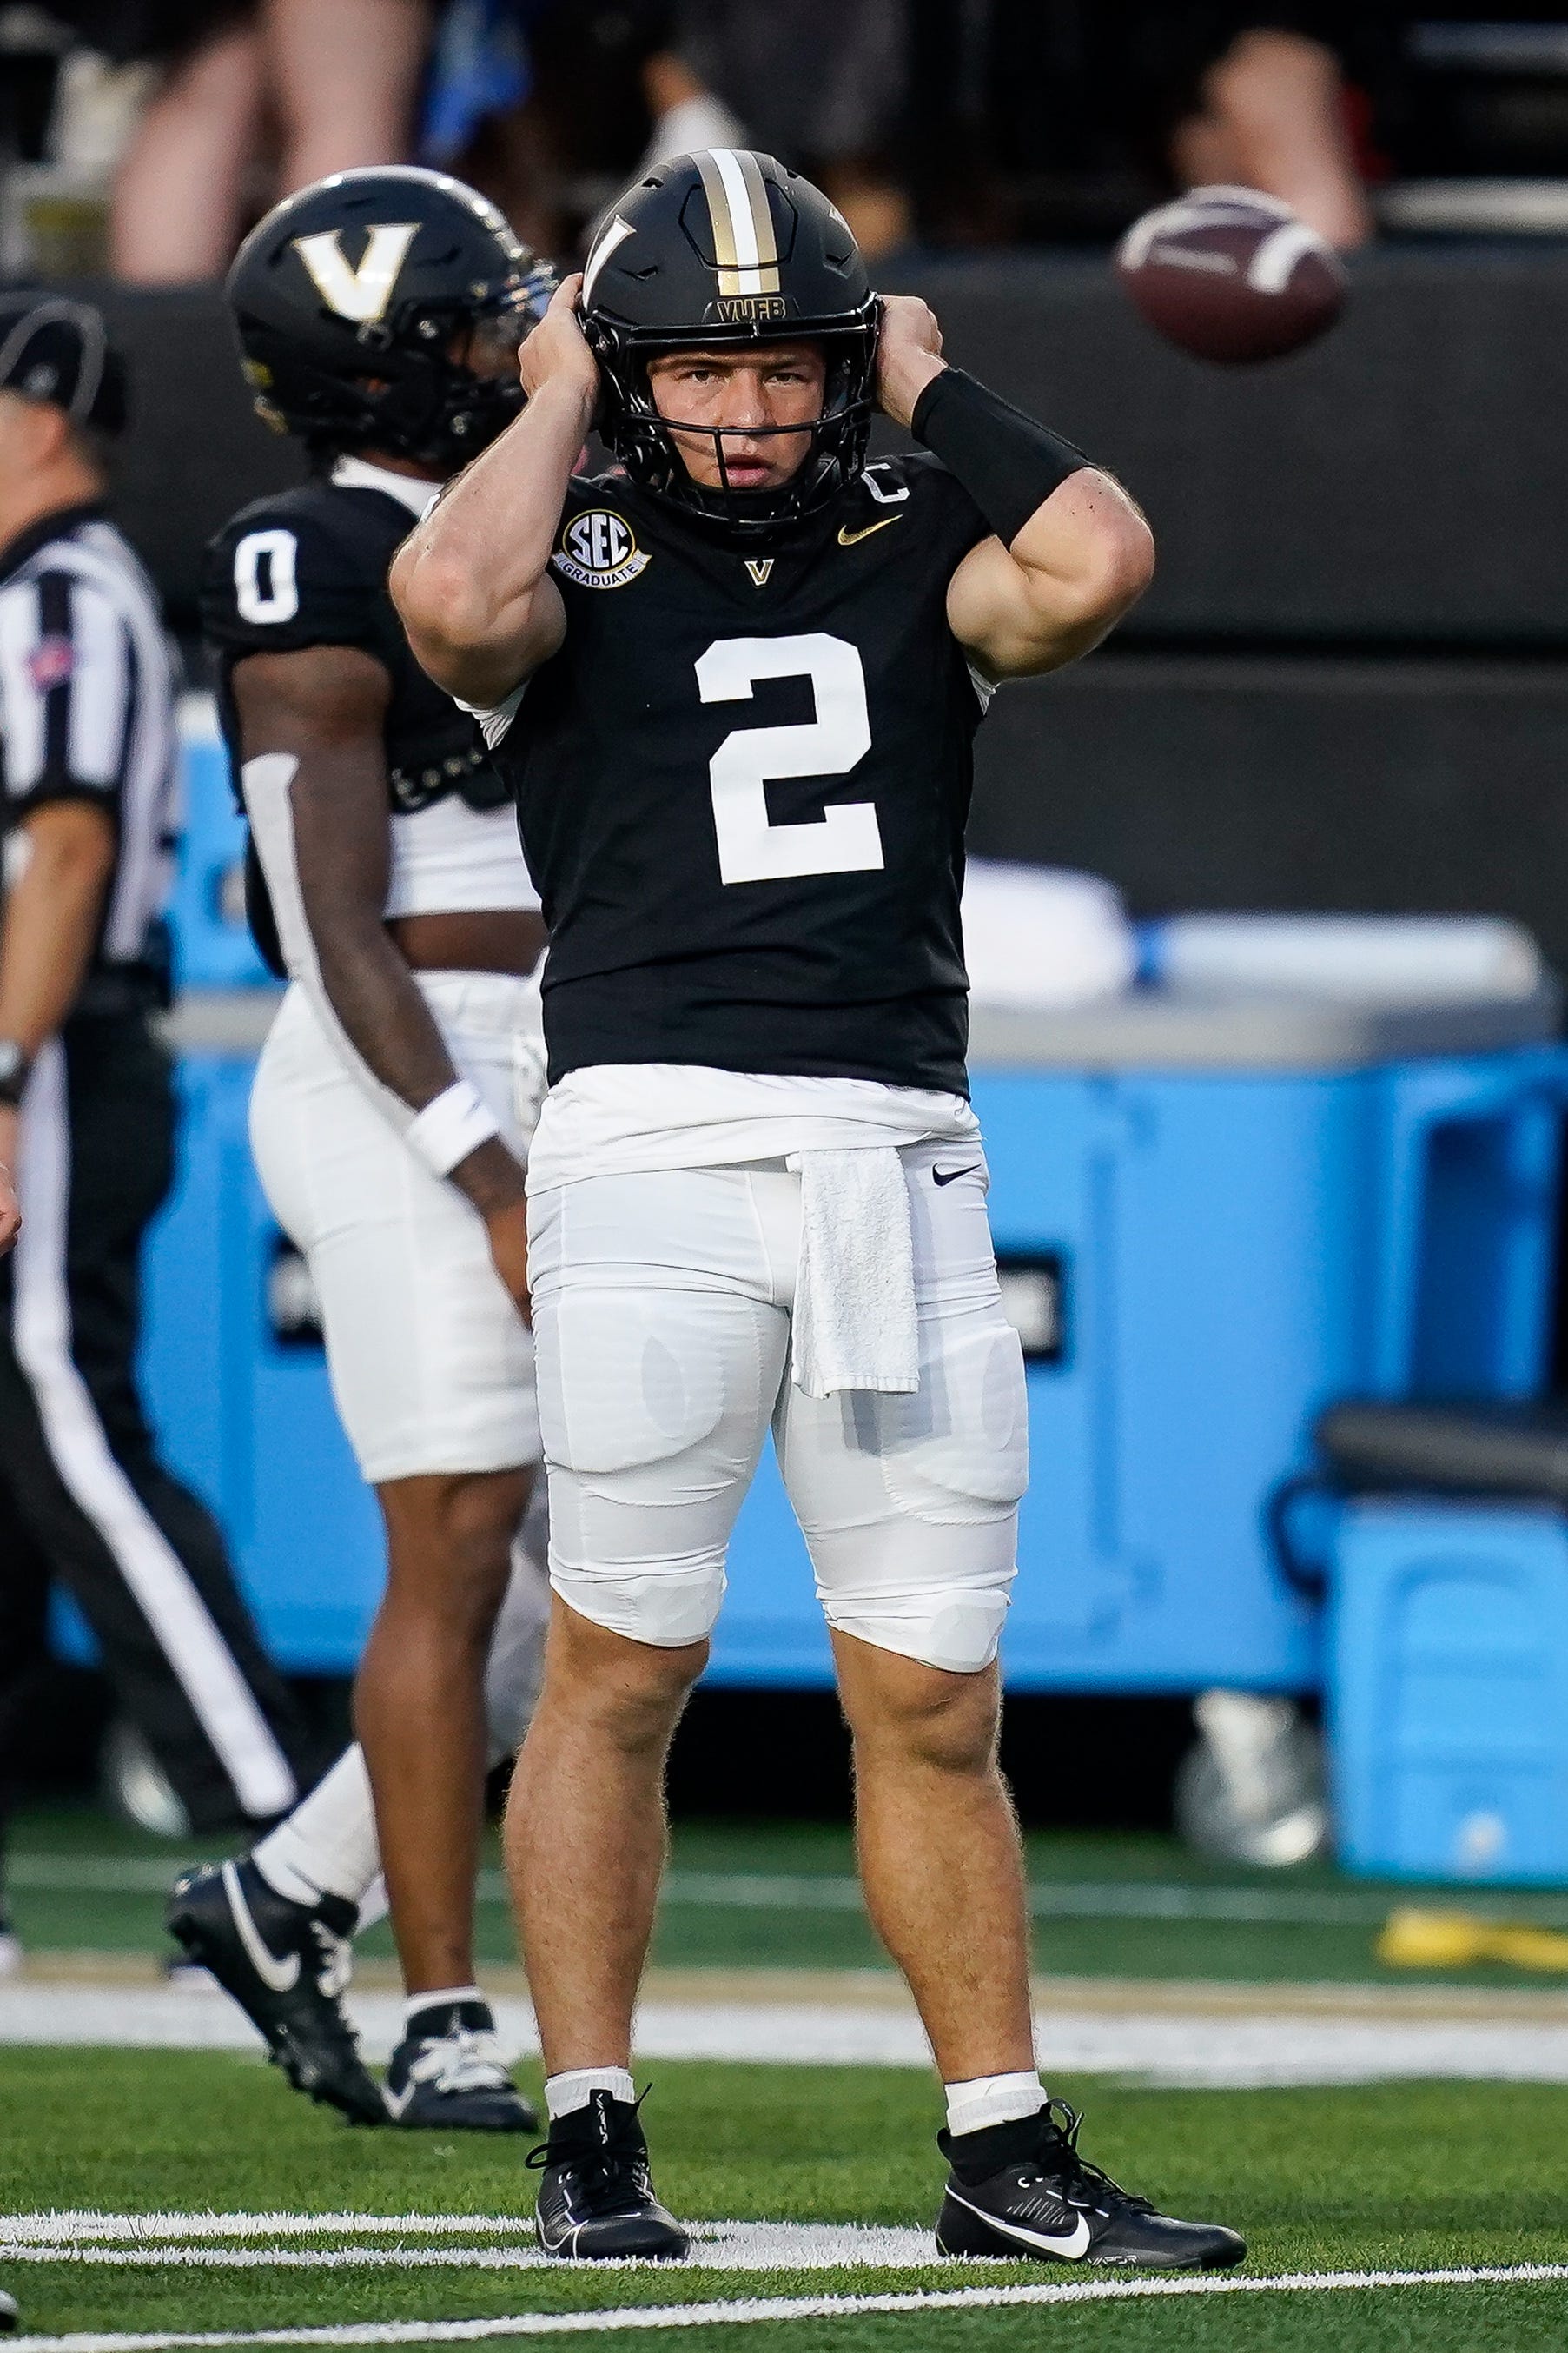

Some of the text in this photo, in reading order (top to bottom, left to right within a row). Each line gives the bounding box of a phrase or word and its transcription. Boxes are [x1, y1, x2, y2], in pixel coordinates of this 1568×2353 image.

[293, 222, 421, 322] V
[717, 296, 786, 321] VUFB
[861, 462, 910, 503] C
[569, 514, 629, 568] SEC
[234, 529, 299, 626] 0
[563, 563, 638, 586] GRADUATE
[744, 558, 775, 586] V
[694, 633, 884, 885] 2
